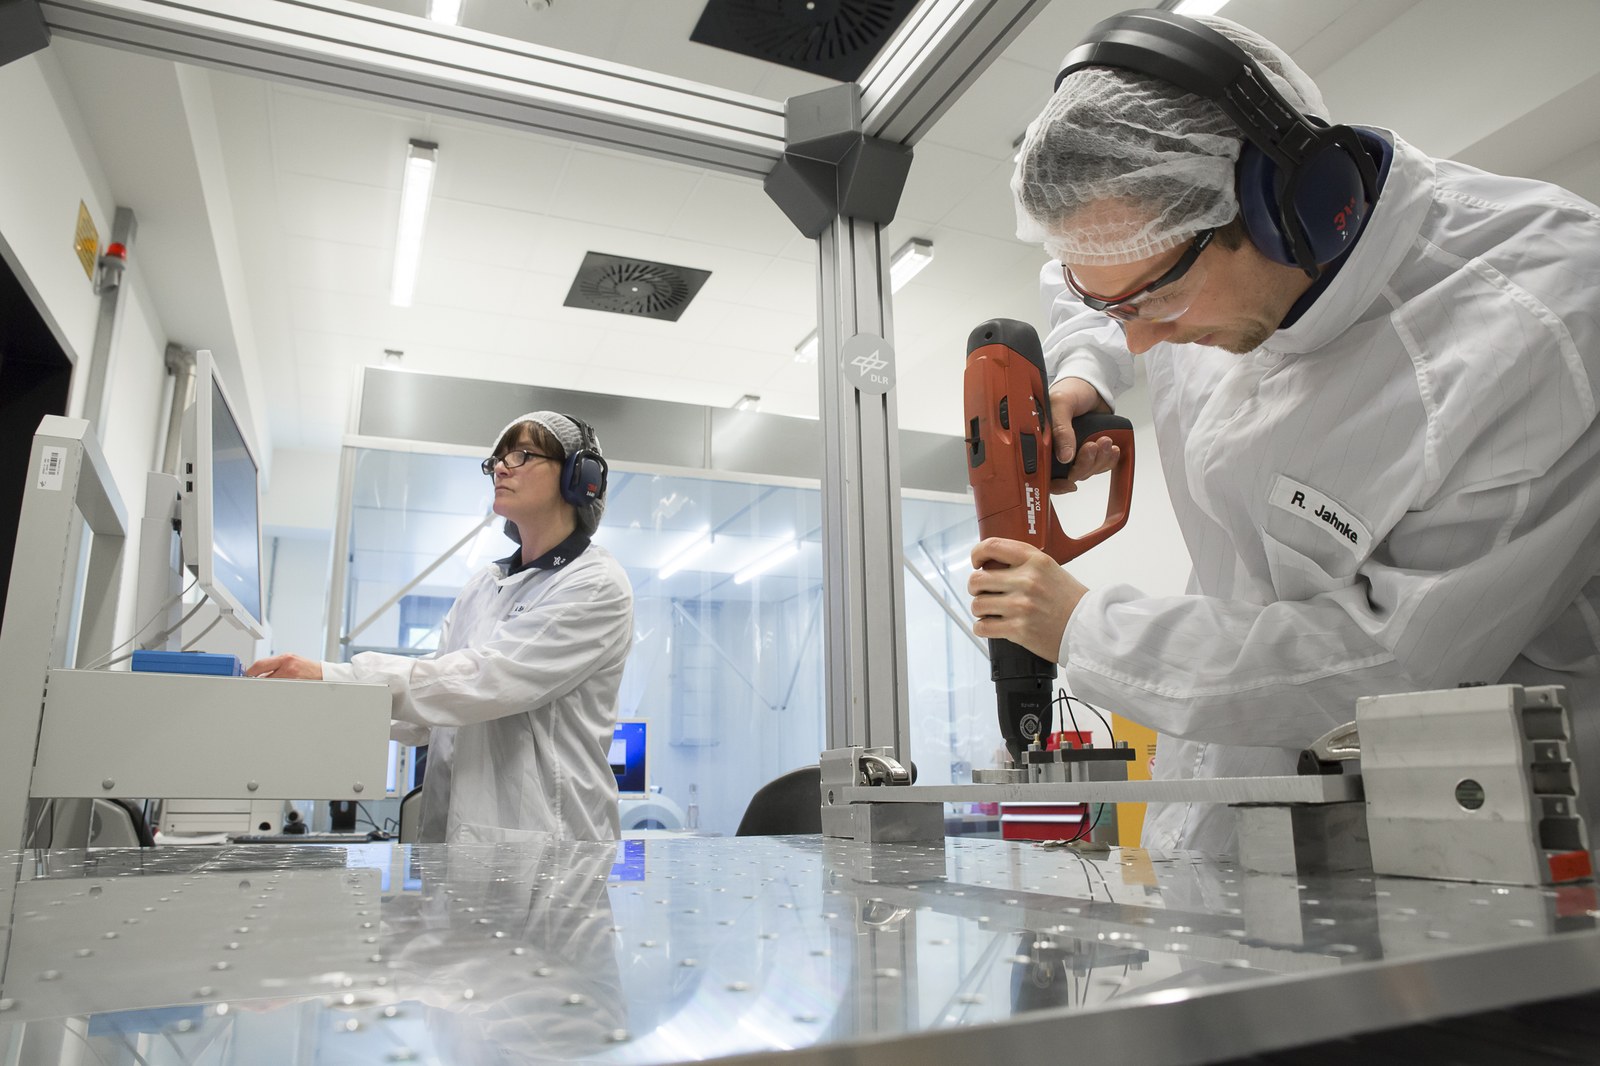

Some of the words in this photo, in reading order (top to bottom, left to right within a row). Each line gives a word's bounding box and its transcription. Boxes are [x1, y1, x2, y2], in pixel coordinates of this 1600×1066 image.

[870, 374, 889, 385] DLR
[1026, 487, 1037, 535] HILTI
[1035, 500, 1041, 511] DX
[1290, 490, 1306, 509] R.
[1314, 504, 1359, 545] Jahnke
